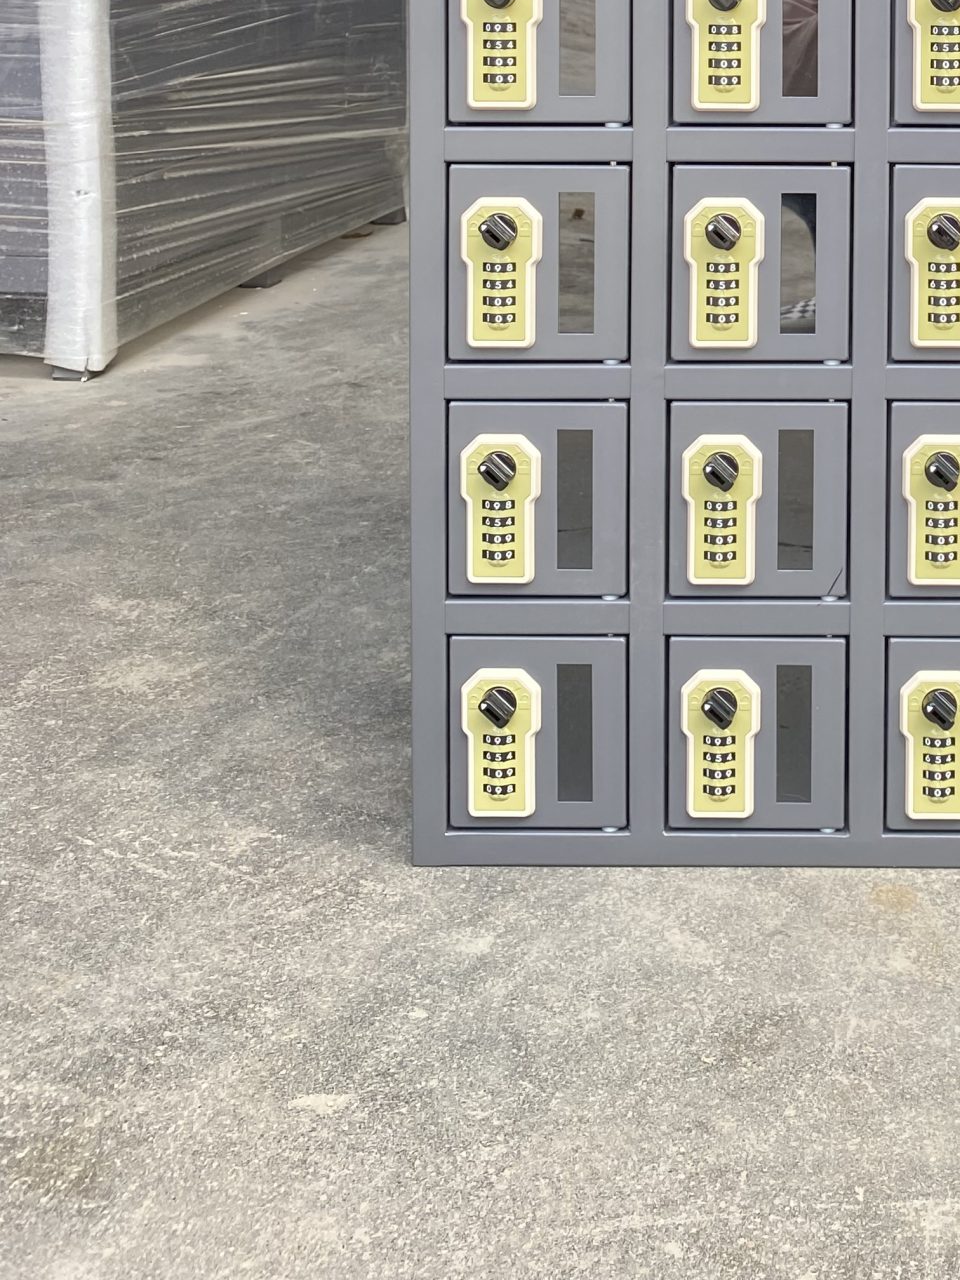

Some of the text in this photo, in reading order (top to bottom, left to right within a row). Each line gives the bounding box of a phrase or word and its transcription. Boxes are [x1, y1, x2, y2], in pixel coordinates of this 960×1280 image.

[485, 22, 513, 32] 098
[711, 26, 738, 35] 098
[932, 25, 960, 35] 098
[486, 41, 513, 49] 654
[711, 43, 738, 52] 654
[932, 42, 959, 52] 654
[487, 56, 514, 67] 109
[712, 60, 739, 68] 109
[933, 61, 960, 69] 109
[487, 73, 514, 83] 109
[712, 75, 738, 85] 109
[933, 77, 960, 86] 109
[485, 262, 513, 274] 098
[708, 264, 736, 274] 098
[930, 262, 957, 274] 098
[485, 279, 513, 291] 654
[709, 281, 736, 291] 654
[930, 279, 957, 290] 654
[486, 296, 513, 308] 109
[709, 296, 736, 308] 109
[930, 296, 957, 307] 109
[486, 313, 513, 324] 109
[709, 313, 736, 324] 109
[930, 313, 957, 324] 109
[484, 500, 512, 512] 098
[706, 501, 734, 512] 098
[927, 501, 955, 512] 098
[485, 517, 512, 528] 654
[707, 517, 734, 529] 654
[927, 518, 955, 529] 654
[485, 533, 513, 545] 109
[707, 534, 734, 546] 109
[928, 534, 955, 546] 109
[486, 550, 513, 561] 109
[707, 551, 734, 563] 109
[928, 551, 955, 563] 109
[485, 734, 513, 746] 098
[705, 734, 732, 747] 098
[924, 737, 952, 749] 098
[486, 751, 512, 763] 654
[705, 752, 733, 764] 654
[925, 754, 951, 765] 654
[487, 768, 513, 779] 109
[706, 768, 733, 780] 109
[925, 770, 952, 781] 109
[486, 784, 514, 796] 098
[706, 785, 733, 796] 109
[925, 787, 952, 799] 109
